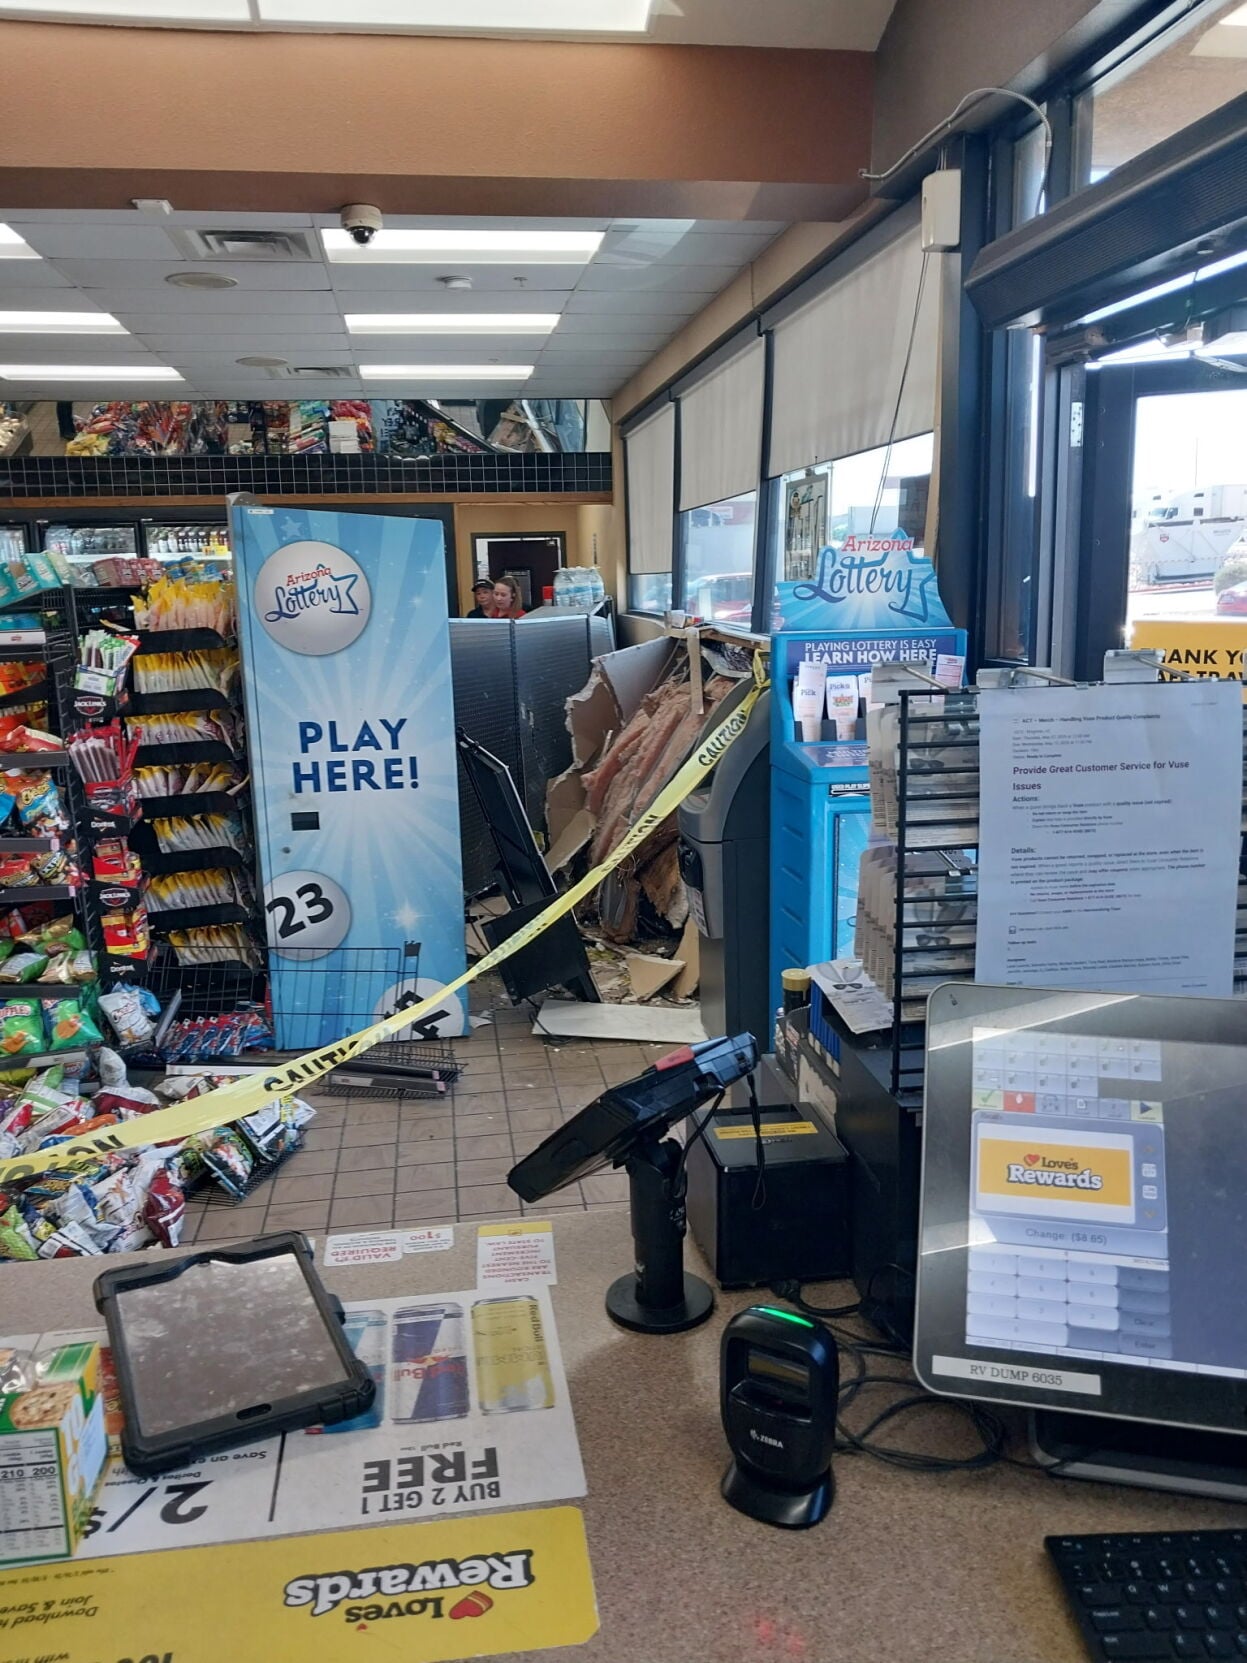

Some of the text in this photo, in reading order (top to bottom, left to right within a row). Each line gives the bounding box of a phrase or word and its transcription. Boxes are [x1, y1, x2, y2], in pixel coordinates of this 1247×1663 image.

[841, 535, 914, 552] Arizona
[286, 567, 332, 586] Arizona
[793, 546, 914, 613] Lottery
[264, 580, 342, 622] Lottery
[805, 639, 937, 651] PLAYING LOTTERY IS EASY
[805, 649, 937, 664] LEARN HOW HERE
[298, 718, 408, 754] PLAY
[697, 709, 748, 768] CAUTION
[292, 756, 419, 794] HERE!
[1012, 760, 1190, 775] Provide Great Customer Service for Vuse
[1012, 781, 1042, 791] Issues
[266, 882, 334, 939] 23
[1042, 1156, 1079, 1170] Love's
[1007, 1164, 1103, 1190] Rewards
[331, 1246, 397, 1257] REQUIRED
[352, 1252, 391, 1261] VALID
[970, 1365, 1063, 1386] RV DUMP 6035
[210, 1455, 227, 1463] an
[232, 1450, 268, 1462] Save
[0, 1469, 25, 1479] 210
[33, 1466, 56, 1476] 200
[162, 1471, 202, 1481] Doritos
[362, 1447, 499, 1493] FREE
[362, 1481, 501, 1515] BUY 2 GET 1
[284, 1549, 536, 1618] Rewards
[61, 1594, 94, 1608] Join
[11, 1606, 99, 1629] Download
